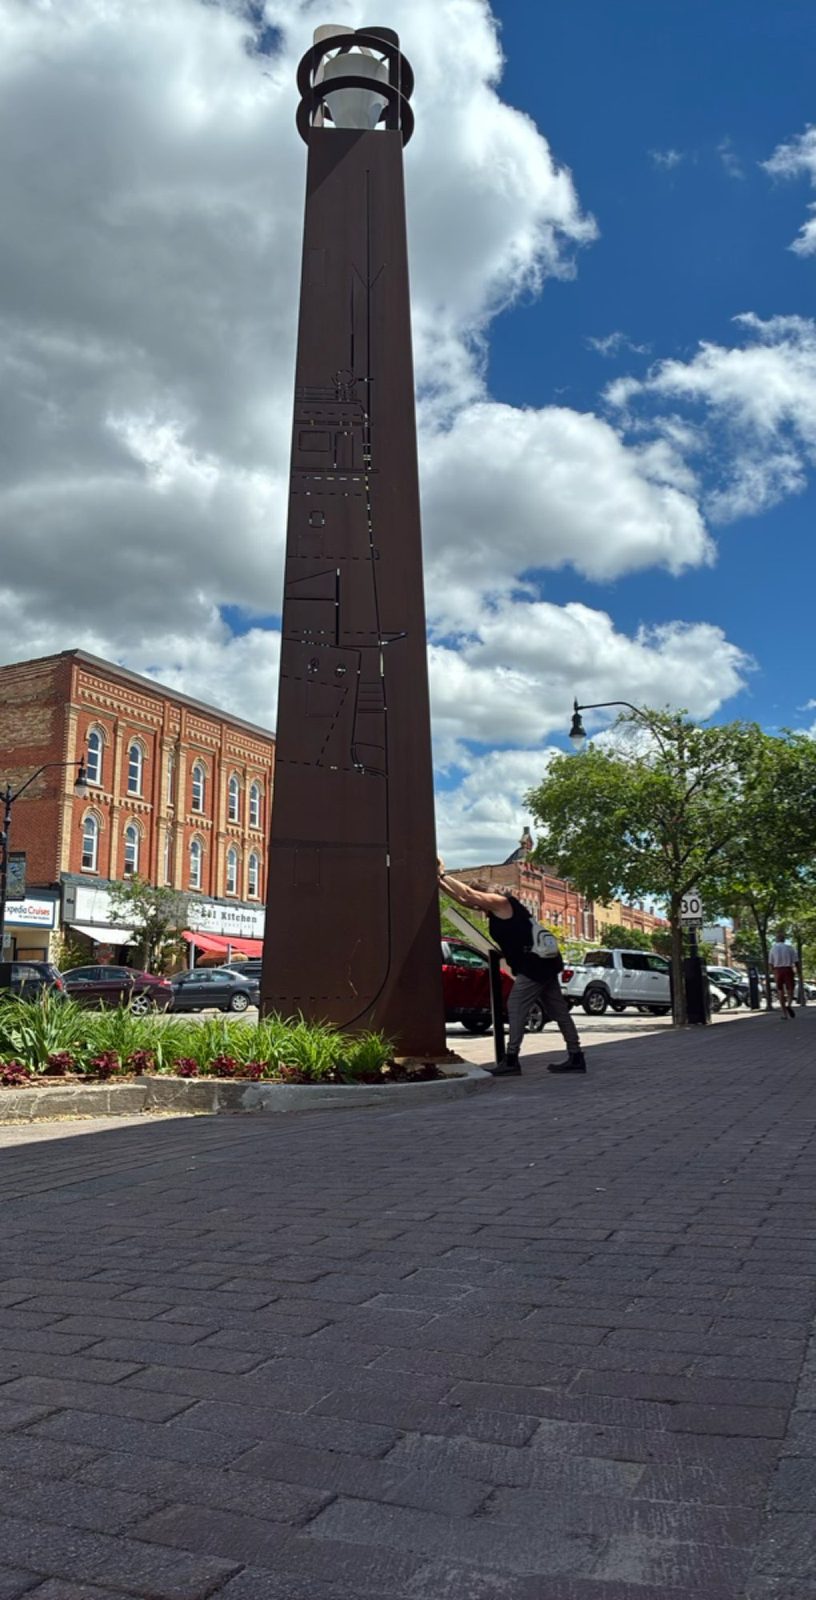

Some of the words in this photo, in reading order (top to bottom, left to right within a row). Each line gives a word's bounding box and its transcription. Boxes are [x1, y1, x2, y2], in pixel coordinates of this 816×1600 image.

[28, 906, 50, 916] Cruises
[681, 899, 700, 913] 30
[221, 911, 257, 923] Kitchen
